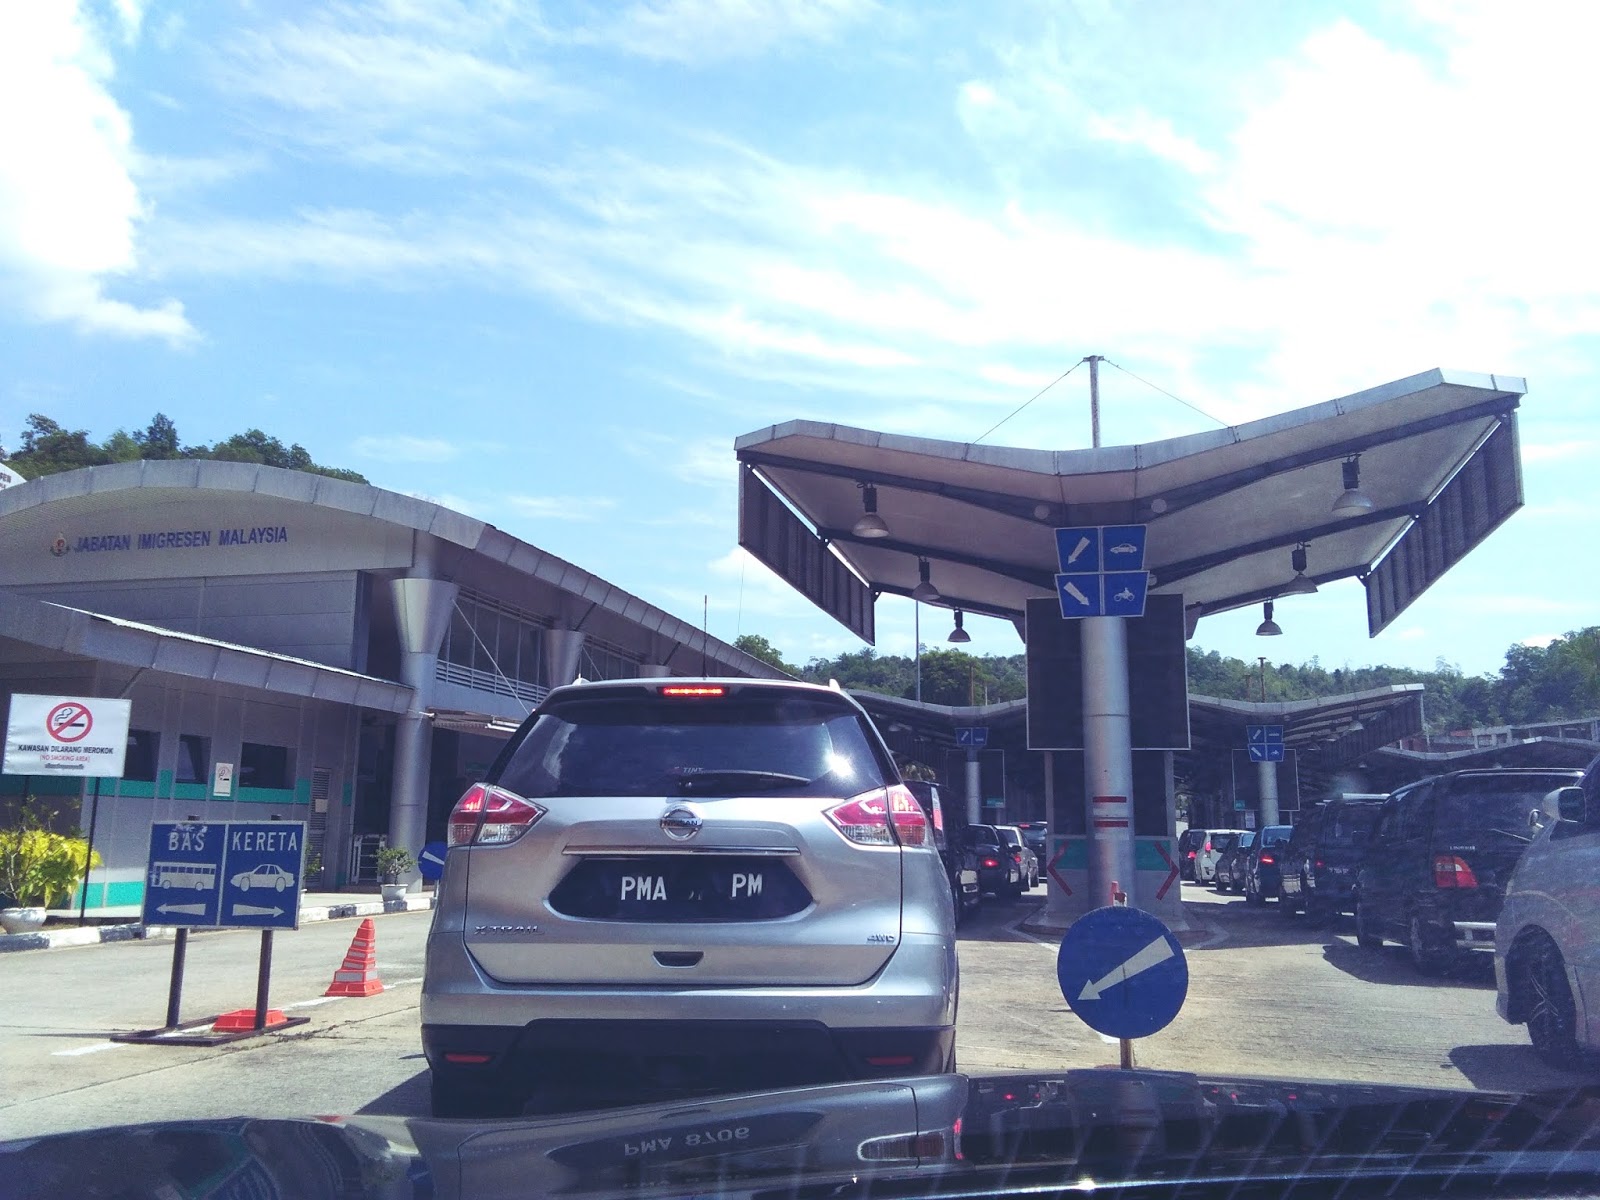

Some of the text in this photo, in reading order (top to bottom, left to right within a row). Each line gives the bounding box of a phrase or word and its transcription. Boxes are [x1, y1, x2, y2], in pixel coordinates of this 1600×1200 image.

[75, 526, 288, 553] JABATAN IMIGRESEN MALAYSIA
[18, 744, 114, 754] KAWASAN DILARANG MEROKOK
[168, 831, 206, 851] BAS
[232, 831, 298, 852] KERETA
[620, 873, 763, 901] PMA PM
